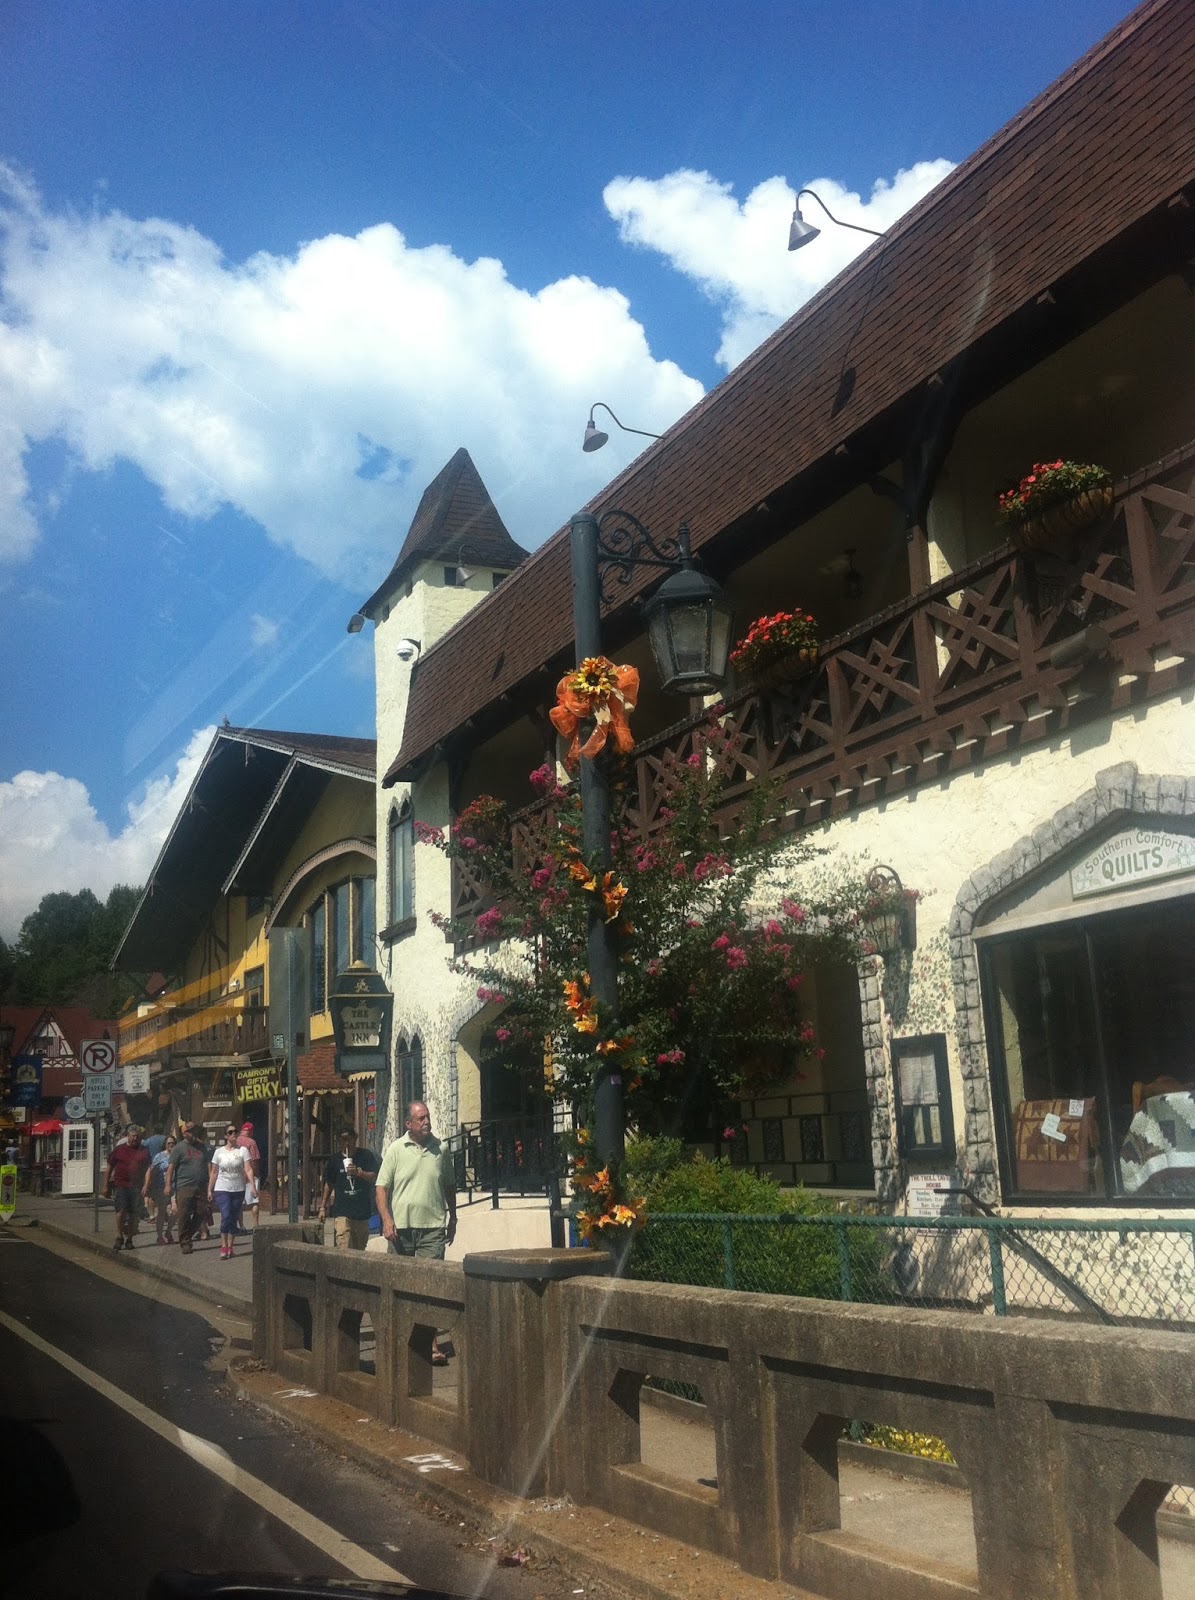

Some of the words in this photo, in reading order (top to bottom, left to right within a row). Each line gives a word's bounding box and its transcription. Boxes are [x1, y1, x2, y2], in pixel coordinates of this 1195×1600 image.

[1085, 836, 1132, 874] Southern
[1136, 831, 1184, 854] Comfort
[1101, 846, 1163, 882] QUILTS
[352, 1010, 369, 1018] THE
[343, 1021, 377, 1030] CASTLE
[352, 1033, 370, 1044] INN
[237, 1067, 276, 1079] DAMRON'S
[246, 1076, 269, 1085] GIFTS
[237, 1081, 279, 1101] JERKY
